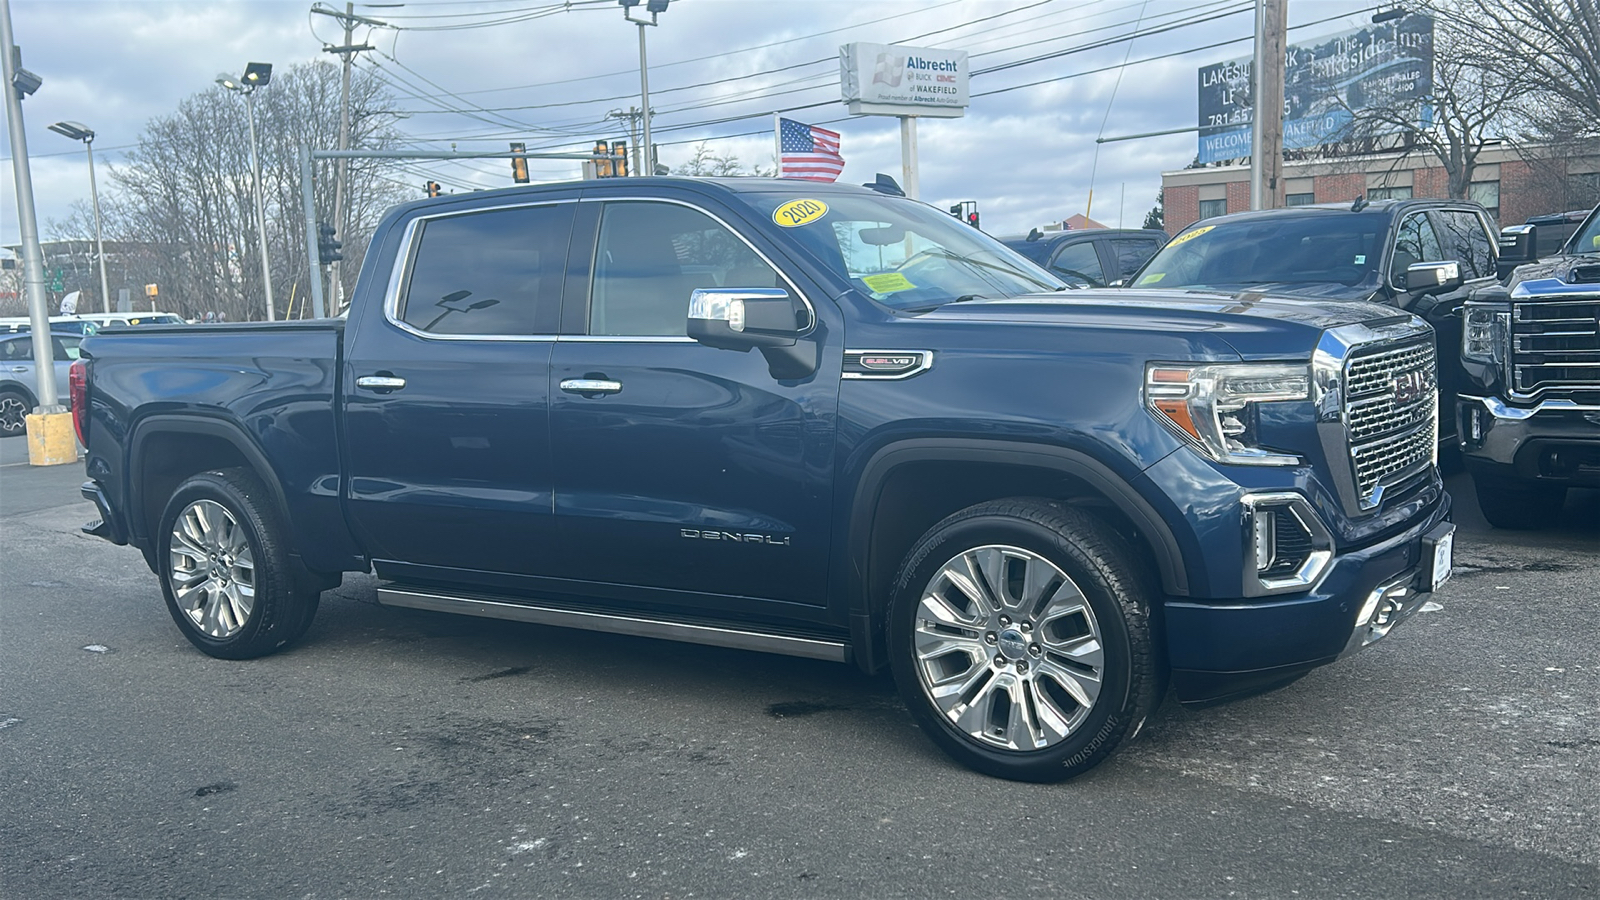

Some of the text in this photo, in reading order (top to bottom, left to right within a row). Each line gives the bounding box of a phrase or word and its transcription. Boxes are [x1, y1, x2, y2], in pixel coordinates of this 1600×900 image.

[1310, 23, 1422, 77] Lakeside Inn
[1335, 36, 1358, 55] The
[907, 56, 957, 72] Albrecht
[915, 72, 956, 83] BUICK GMC
[1397, 70, 1421, 82] SALES
[914, 95, 936, 103] Albrecht
[917, 86, 957, 95] WAKEFIELD
[1206, 131, 1252, 151] WELCOME
[783, 200, 821, 224] 2020
[681, 528, 790, 546] DENALI
[899, 535, 947, 589] BRIDGESTONE
[1062, 714, 1119, 768] BRIDGESTONE
